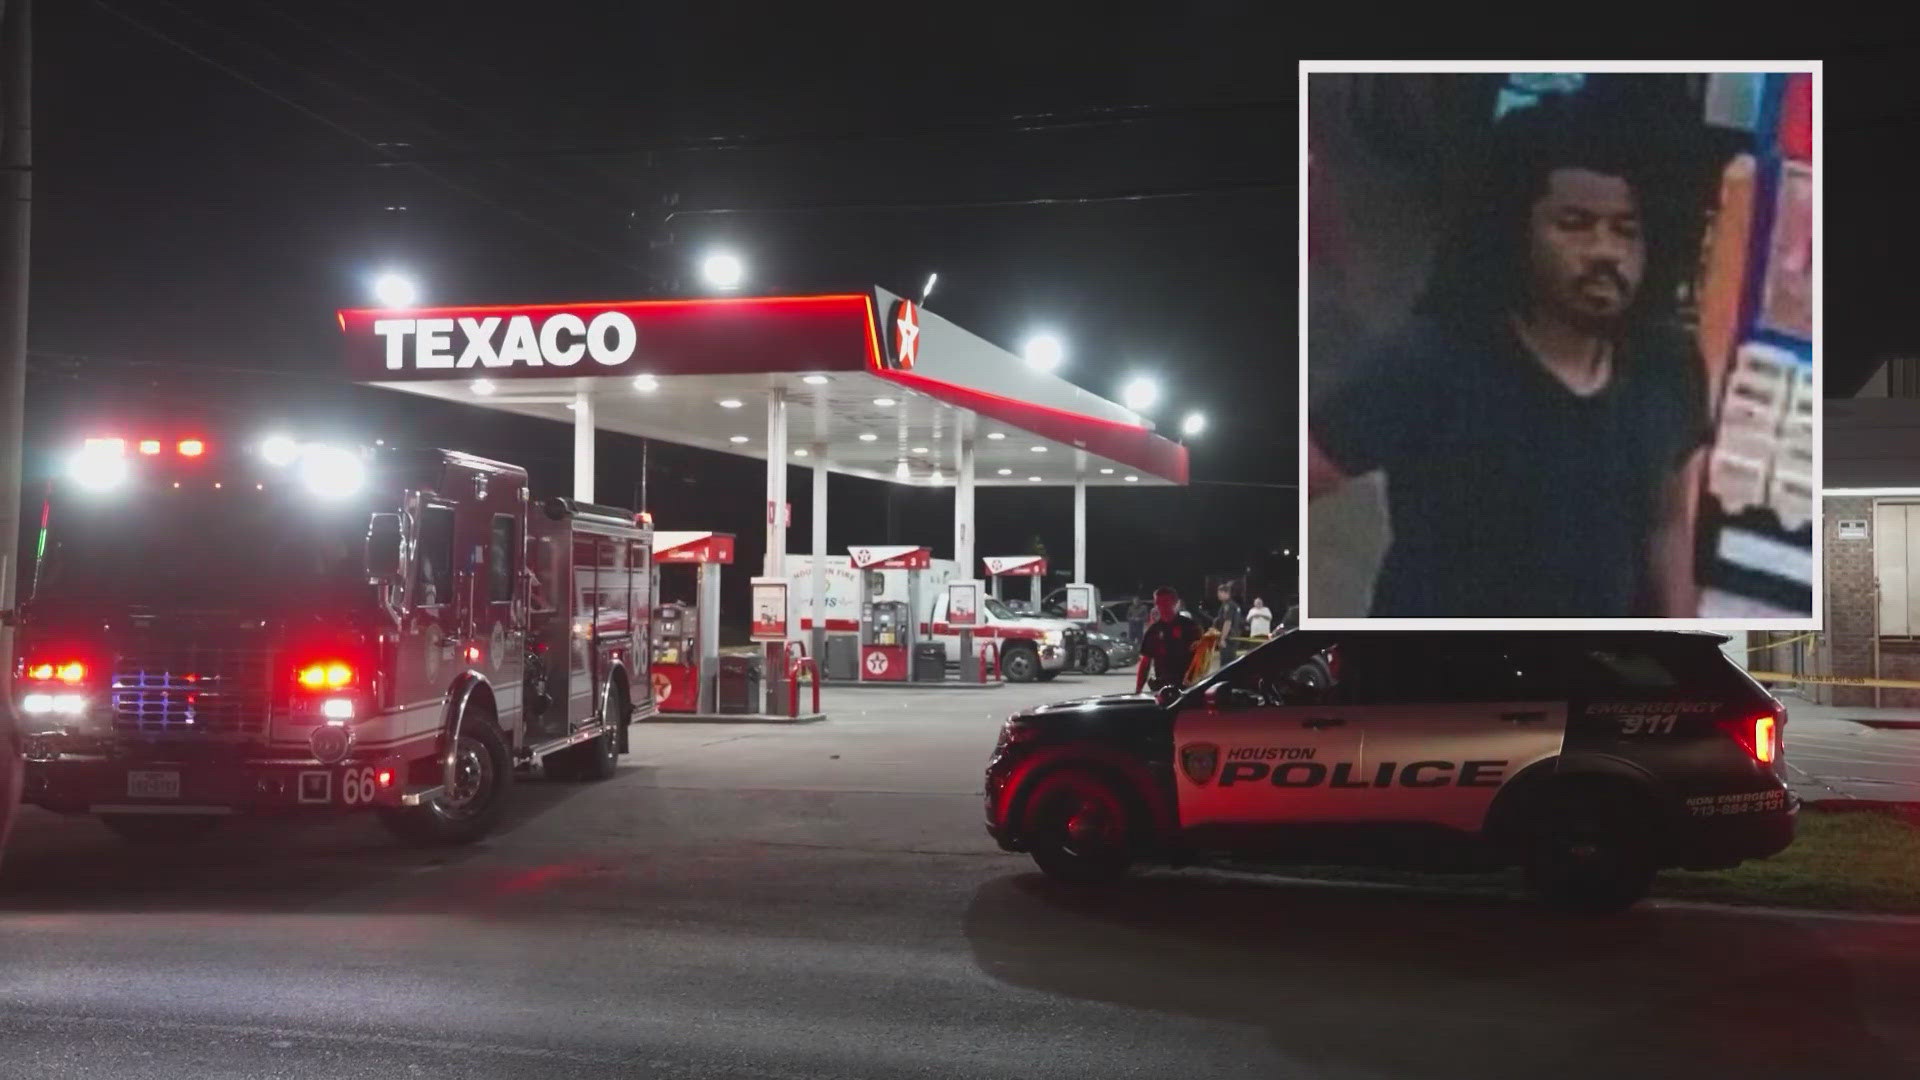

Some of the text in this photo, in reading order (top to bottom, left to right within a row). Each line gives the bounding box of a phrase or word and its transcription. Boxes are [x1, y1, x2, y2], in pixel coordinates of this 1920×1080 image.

[375, 311, 637, 369] TEXACO
[793, 568, 835, 579] HOUN
[1586, 702, 1724, 715] EMERGENCY
[1618, 714, 1678, 735] 911
[1227, 747, 1316, 760] HOUSTON
[1218, 760, 1508, 788] POLICE
[342, 767, 376, 804] 66
[1686, 790, 1785, 806] NON EMERGENCY
